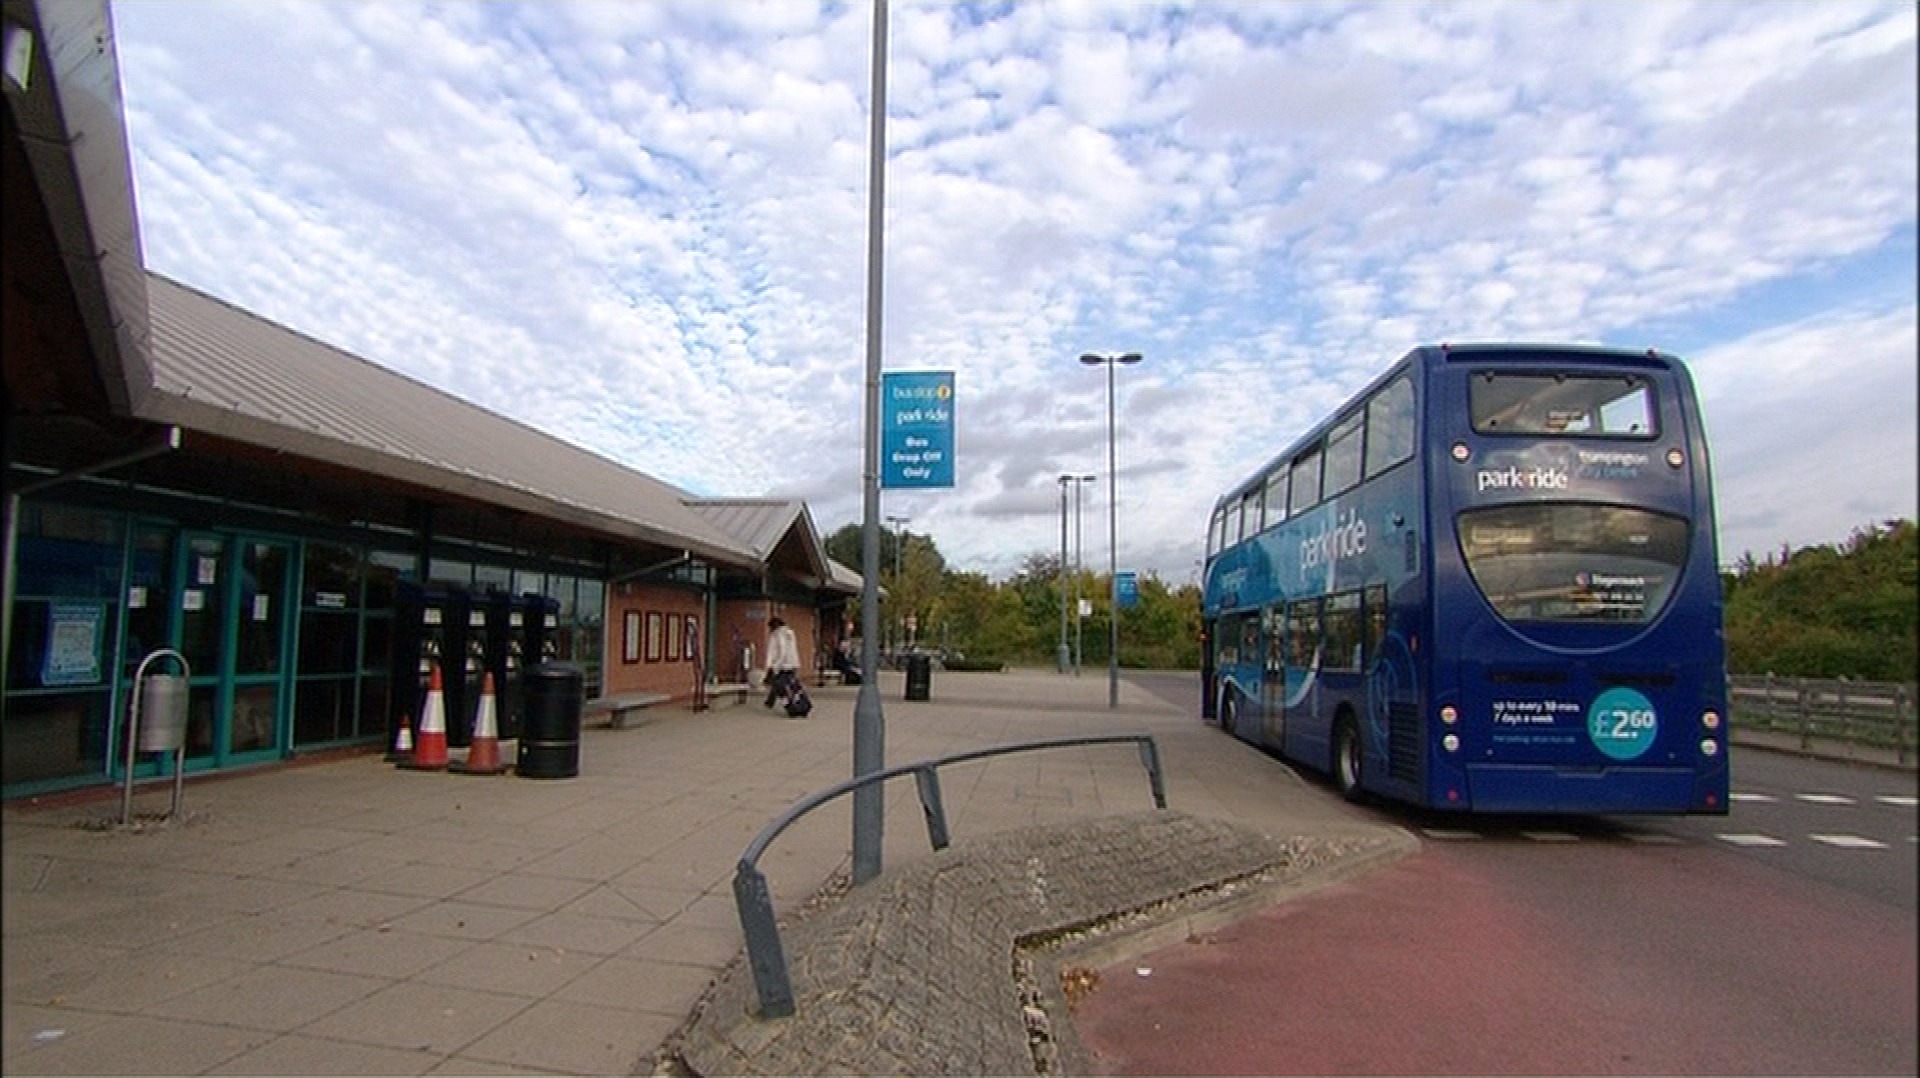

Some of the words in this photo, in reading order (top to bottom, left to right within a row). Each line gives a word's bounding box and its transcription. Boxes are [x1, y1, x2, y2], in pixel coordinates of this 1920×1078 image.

[905, 436, 928, 447] Bus
[893, 452, 920, 463] Drop
[903, 466, 930, 478] Only
[1518, 703, 1542, 712] every
